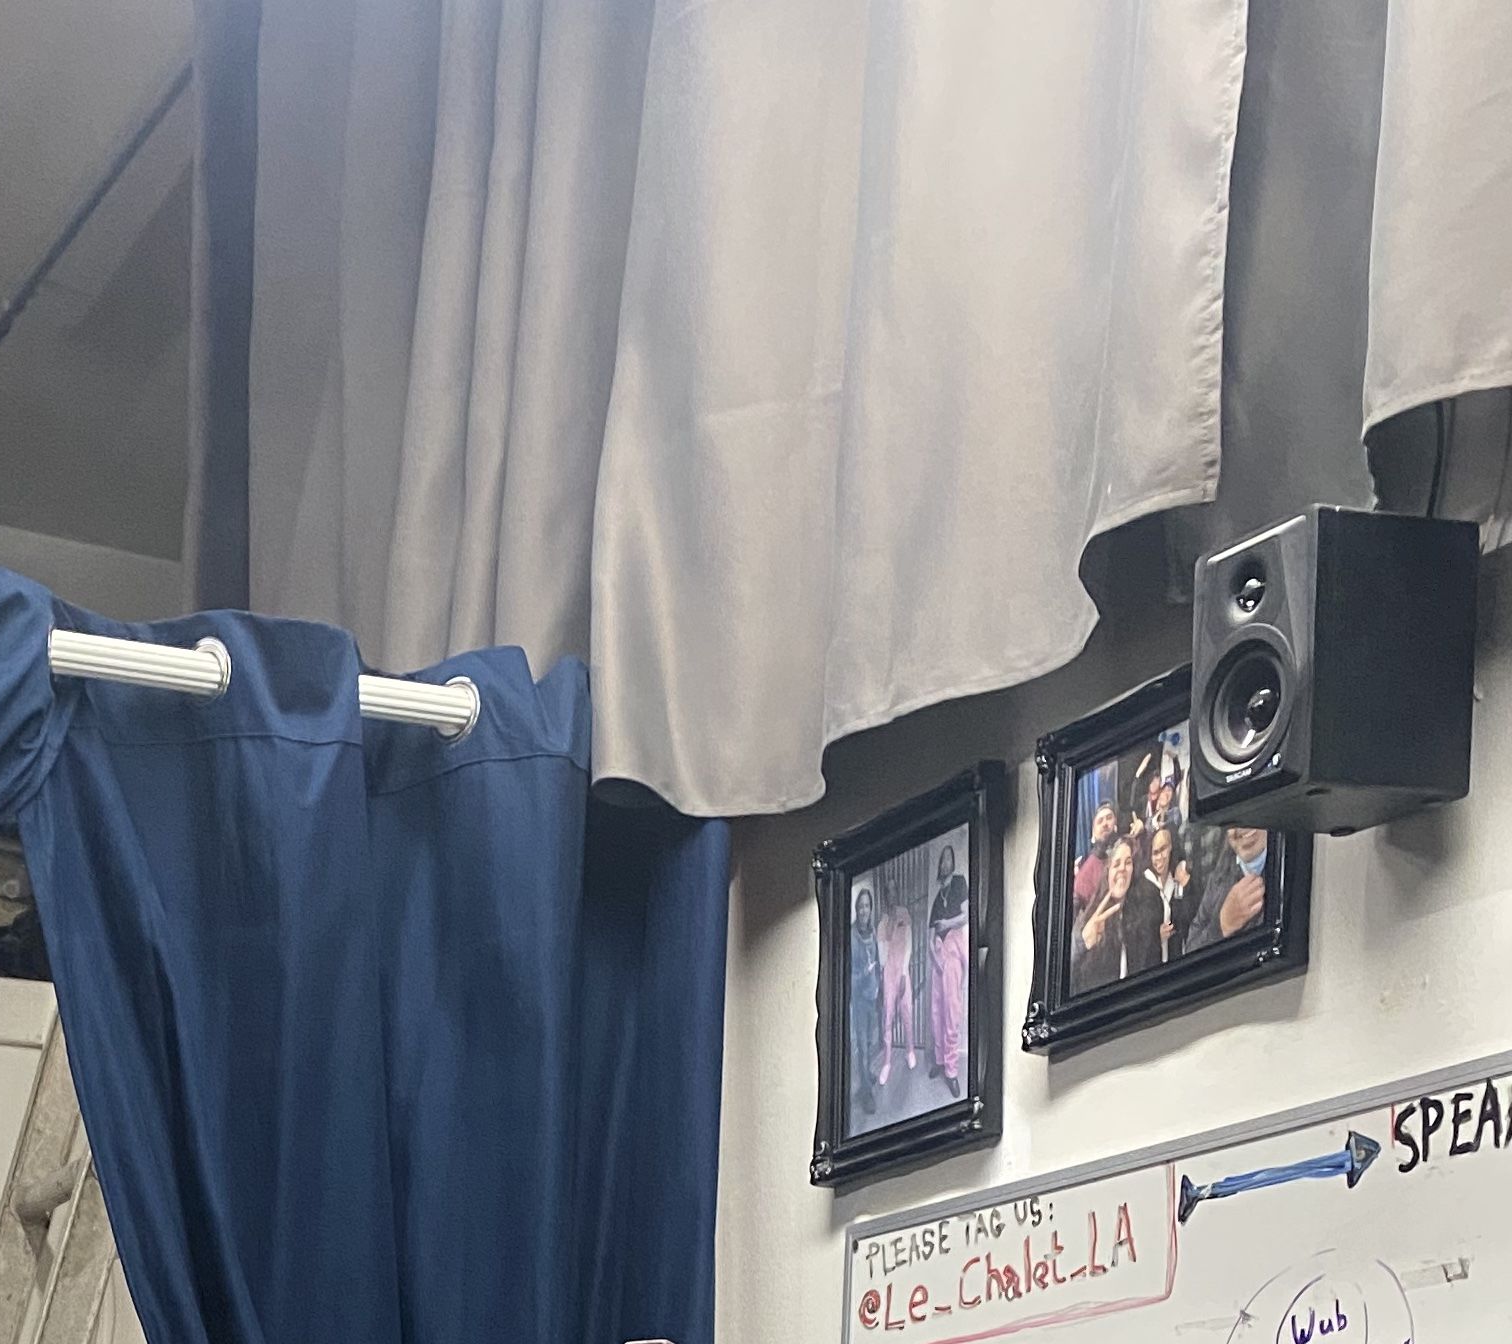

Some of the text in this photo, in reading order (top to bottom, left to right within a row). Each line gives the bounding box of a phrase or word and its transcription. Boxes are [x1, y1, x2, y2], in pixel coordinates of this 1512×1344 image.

[1394, 1077, 1512, 1173] SPEA
[866, 1221, 951, 1279] PLEASE
[965, 1208, 1006, 1246] TAG
